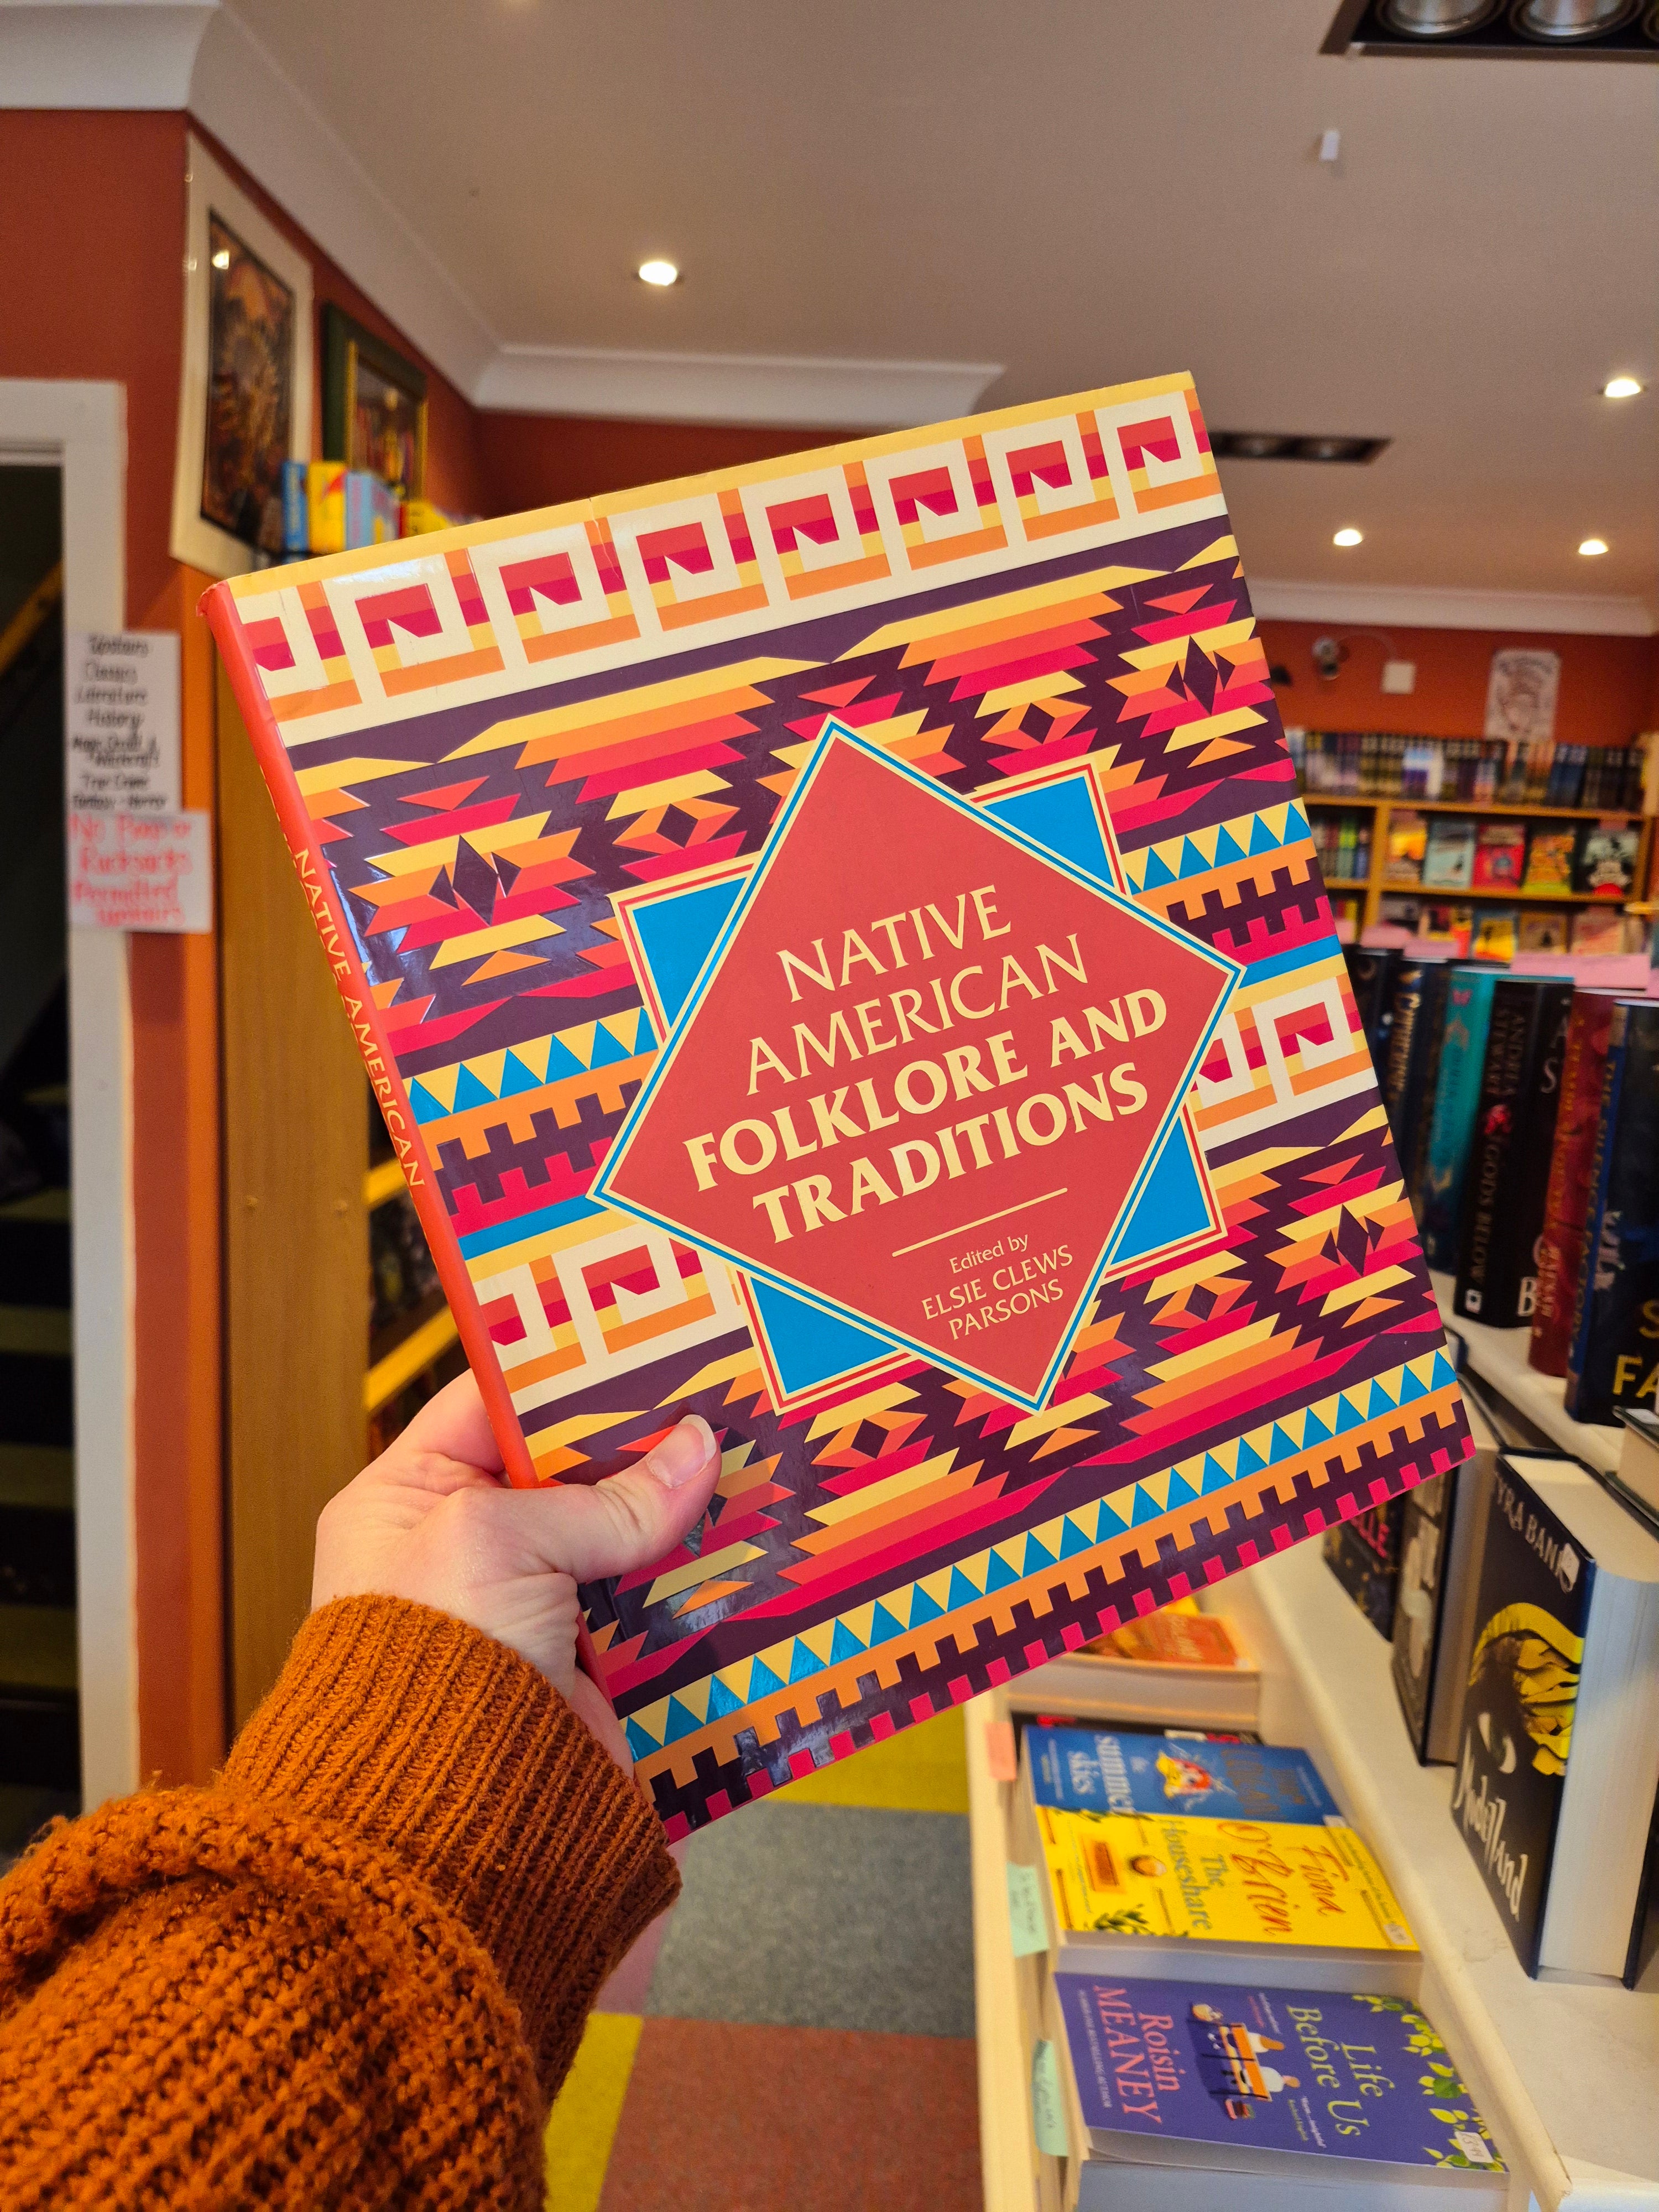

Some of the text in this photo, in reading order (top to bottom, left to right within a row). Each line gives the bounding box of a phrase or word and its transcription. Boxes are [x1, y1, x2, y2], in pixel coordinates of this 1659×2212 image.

[776, 885, 1011, 1002] NATIVE
[295, 848, 425, 1186] NATIVE AMERICAN
[747, 933, 1088, 1095] AMERICAN
[683, 989, 1167, 1192] FOLKLORE AND
[753, 1062, 1147, 1244] TRADITIONS
[921, 1244, 1073, 1320] ELSIE CLEWS
[949, 1234, 1028, 1274] Edited by
[948, 1279, 1063, 1340] PARSONS
[1067, 1750, 1100, 1796] skies
[1094, 1734, 1136, 1813] summer
[1160, 1817, 1212, 1931] Houseshare
[1200, 1853, 1228, 1888] The
[1285, 1845, 1350, 1915] Fiona
[1092, 1984, 1163, 2124] MEANEY
[1138, 2012, 1187, 2091] Roisin
[1286, 2005, 1370, 2136] Before Us
[1341, 2041, 1395, 2098] Life
